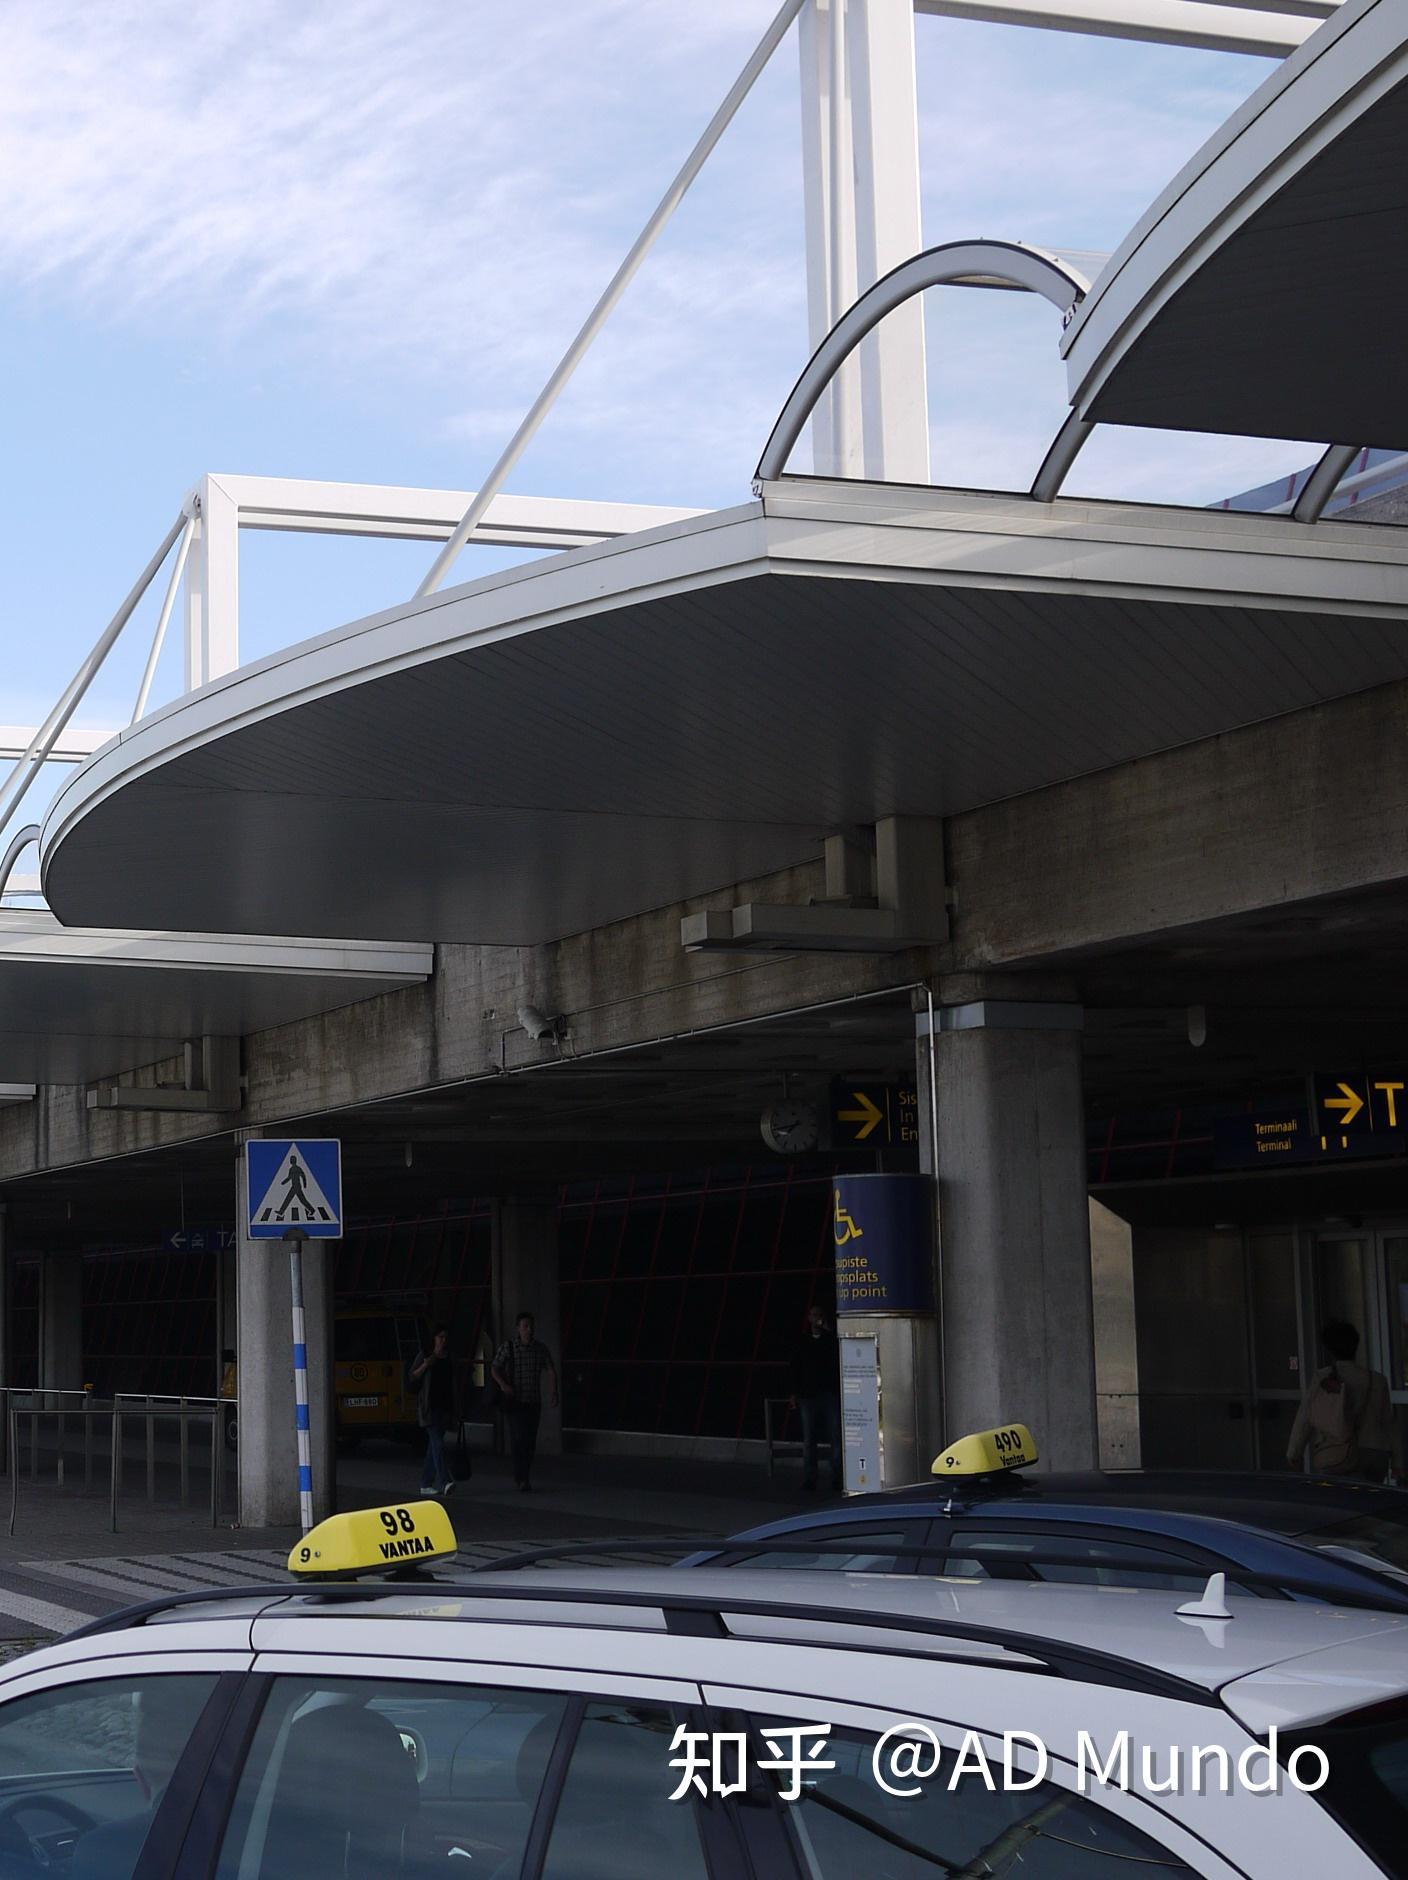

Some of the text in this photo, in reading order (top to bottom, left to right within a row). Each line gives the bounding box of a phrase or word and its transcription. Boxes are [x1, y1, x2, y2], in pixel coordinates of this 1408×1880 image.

[1374, 1081, 1405, 1127] T
[1254, 1119, 1298, 1136] Terminaali
[1256, 1137, 1293, 1152] Terminal
[852, 1284, 887, 1300] point
[994, 1429, 1022, 1453] 490
[946, 1456, 955, 1468] 9
[379, 1508, 415, 1536] 98
[300, 1548, 311, 1563] 9
[378, 1536, 435, 1560] VANTAA
